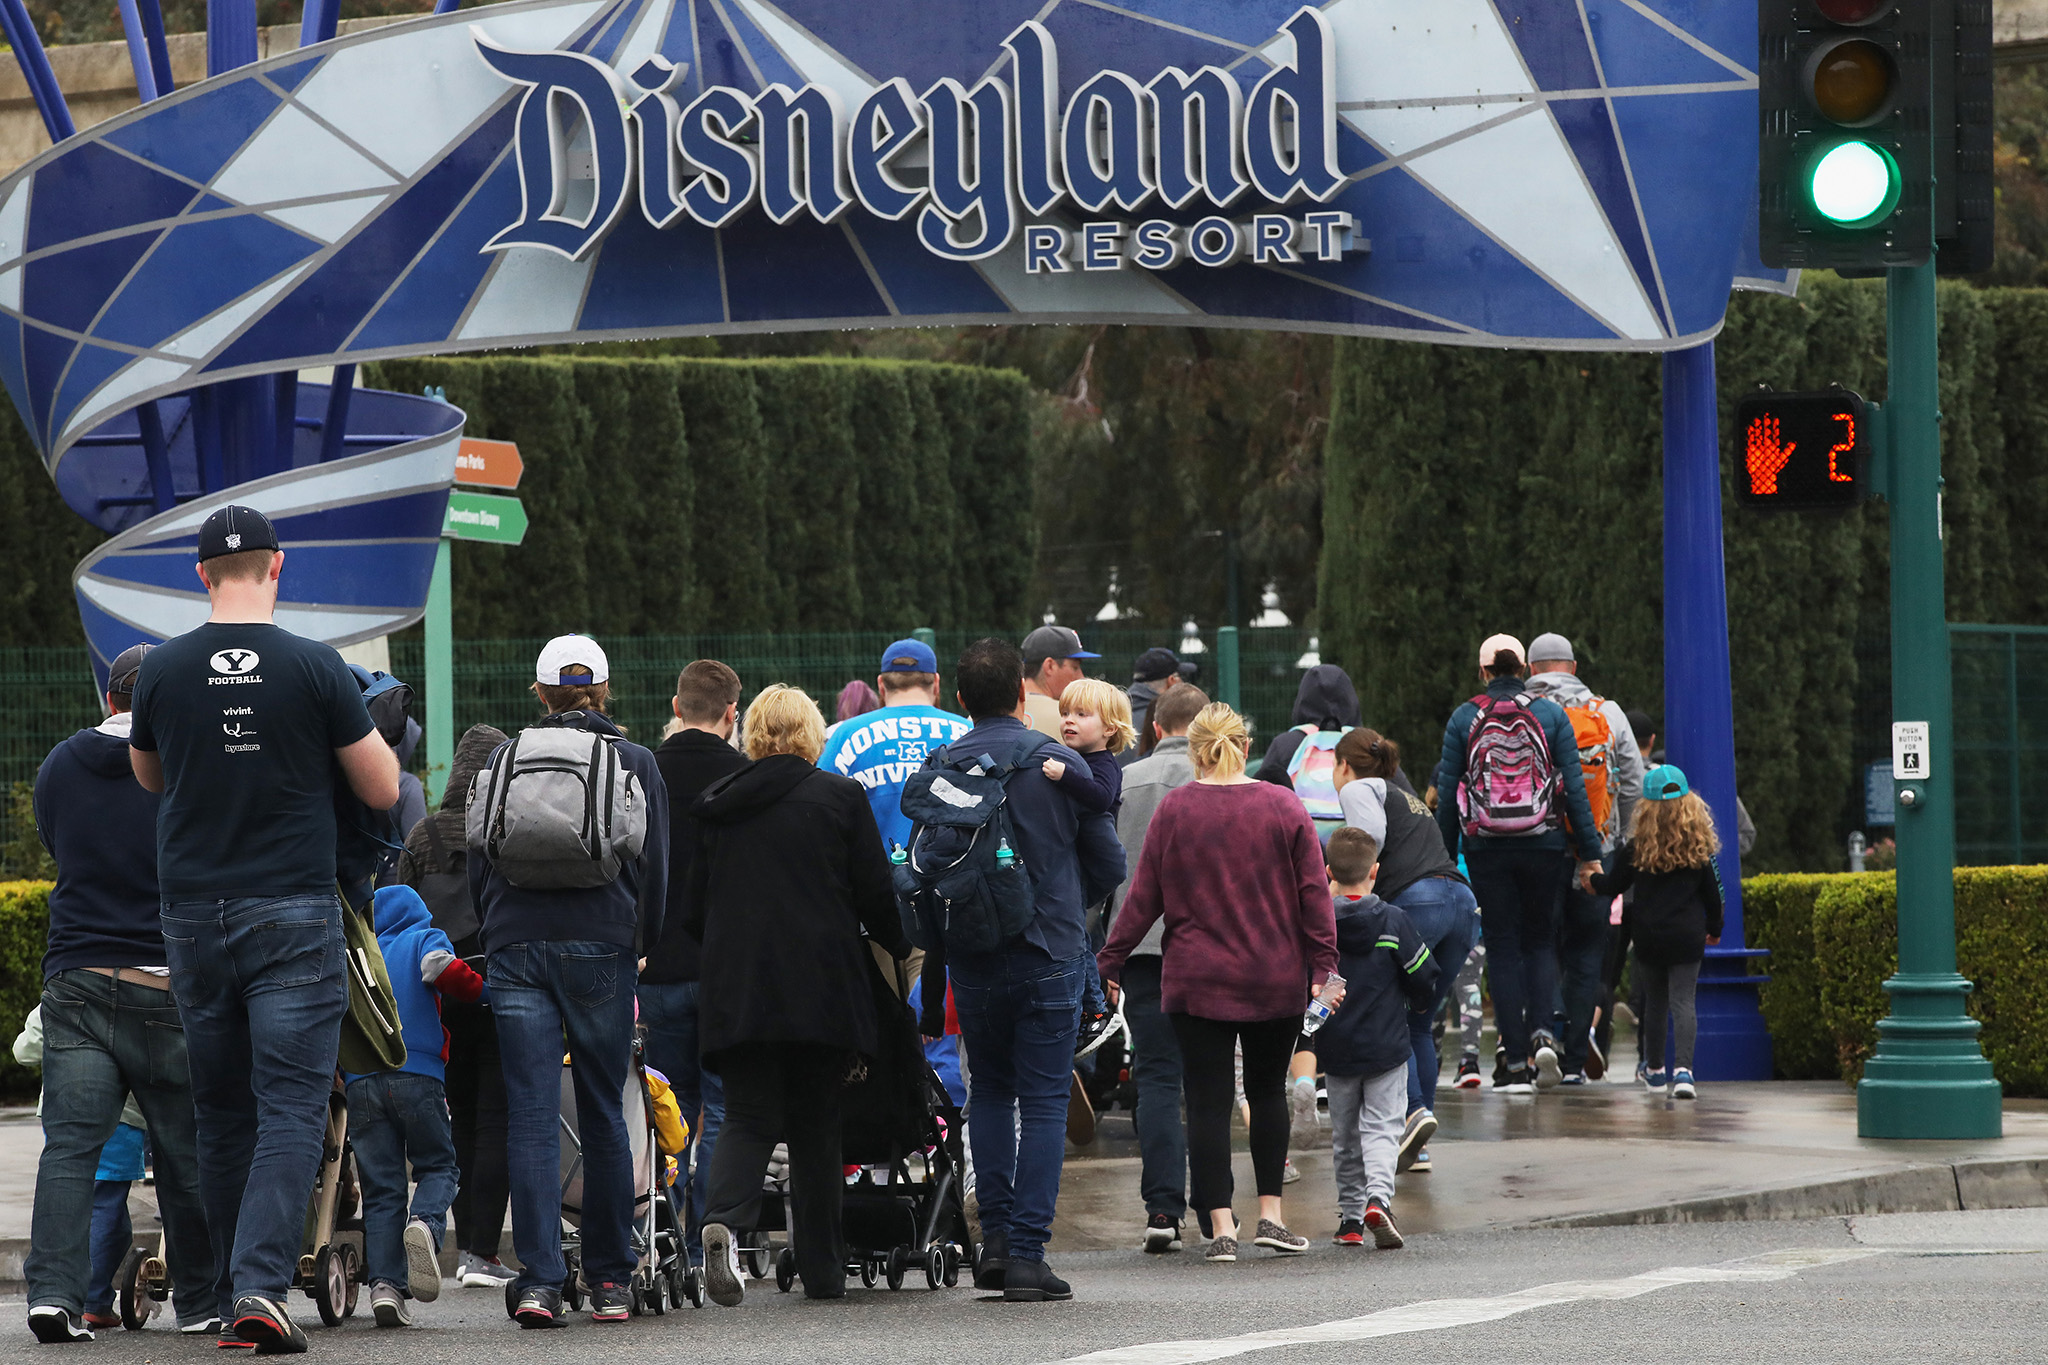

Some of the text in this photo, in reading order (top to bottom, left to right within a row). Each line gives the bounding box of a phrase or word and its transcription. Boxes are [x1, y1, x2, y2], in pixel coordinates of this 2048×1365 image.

[468, 5, 1353, 263] Disneyland
[1024, 211, 1352, 274] RESORT
[1828, 413, 1855, 482] 2
[480, 509, 500, 530] Disney
[218, 651, 251, 671] Y
[207, 675, 263, 685] FOOTBALL
[834, 716, 974, 778] MONSTE
[1898, 735, 1923, 743] BUTTON
[1904, 743, 1917, 751] FOR
